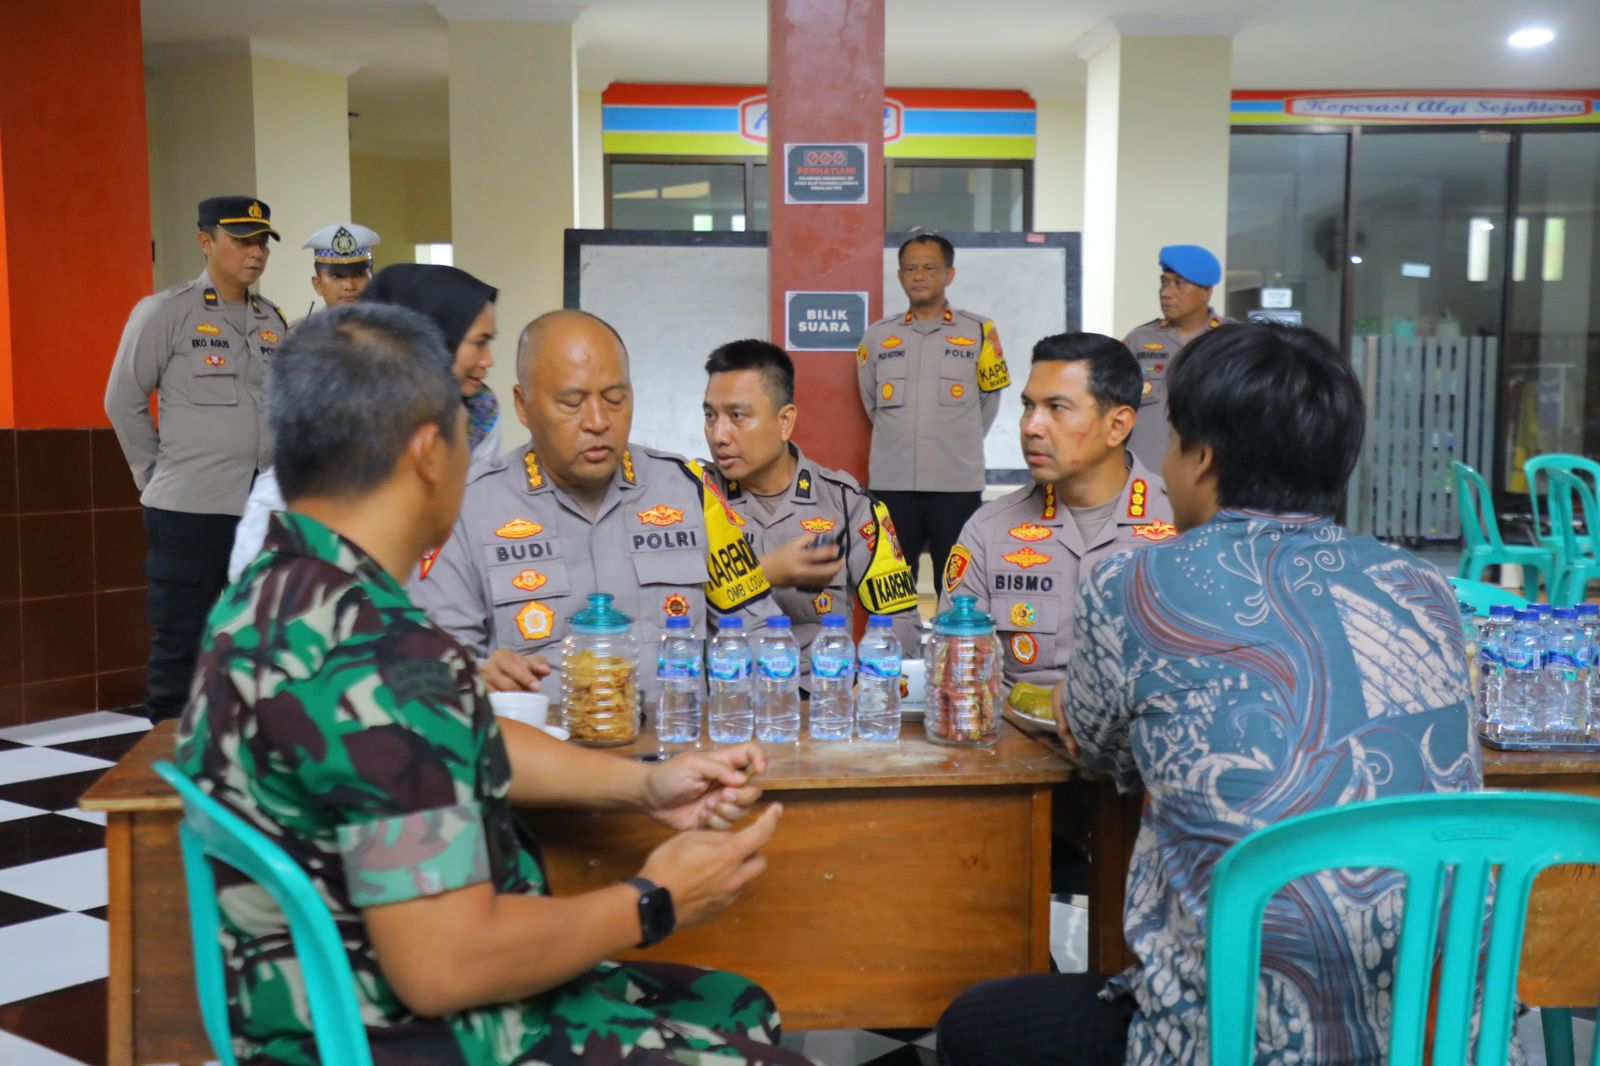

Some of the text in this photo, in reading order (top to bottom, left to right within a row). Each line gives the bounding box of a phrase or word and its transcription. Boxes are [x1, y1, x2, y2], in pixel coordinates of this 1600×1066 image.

[1475, 100, 1583, 117] Sejahtera
[806, 309, 848, 320] BILIK
[798, 321, 851, 333] SUARA
[191, 338, 207, 348] EKO
[945, 349, 975, 360] POLRI
[632, 531, 697, 550] POLRI
[496, 542, 553, 562] BUDI
[995, 575, 1054, 592] BISMO
[726, 583, 746, 602] OMB
